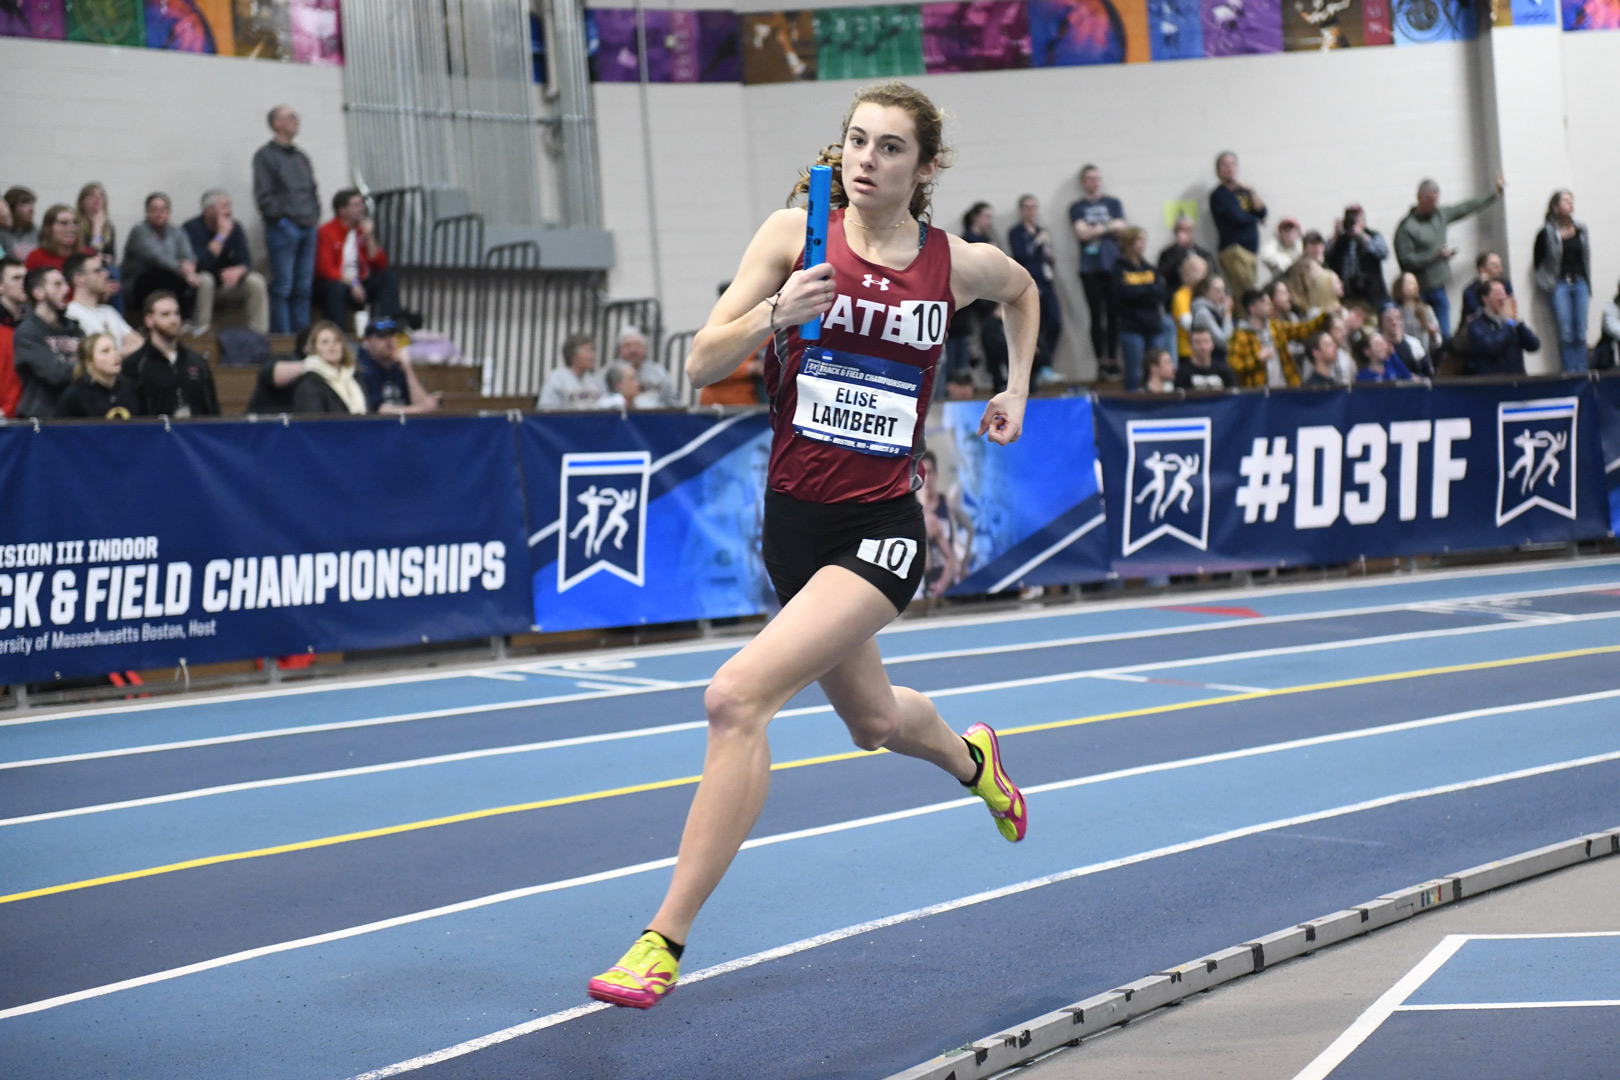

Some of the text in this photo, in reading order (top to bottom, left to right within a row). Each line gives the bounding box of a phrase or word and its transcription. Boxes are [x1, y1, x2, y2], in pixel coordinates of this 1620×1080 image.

[820, 293, 934, 351] ATE
[912, 303, 942, 343] 10
[845, 370, 865, 380] FIELD
[835, 386, 879, 410] ELISE
[811, 402, 899, 438] LAMBERT
[1235, 417, 1472, 530] #D3TF
[56, 539, 85, 565] III
[88, 536, 159, 564] INDOOR
[873, 539, 908, 572] 10
[50, 569, 79, 626] &
[84, 561, 192, 624] FIELD
[202, 540, 506, 613] CHAMPIONSHIPS
[35, 631, 49, 652] of
[52, 626, 140, 650] Massachusetts
[142, 622, 186, 642] Boston,
[188, 618, 217, 638] Host
